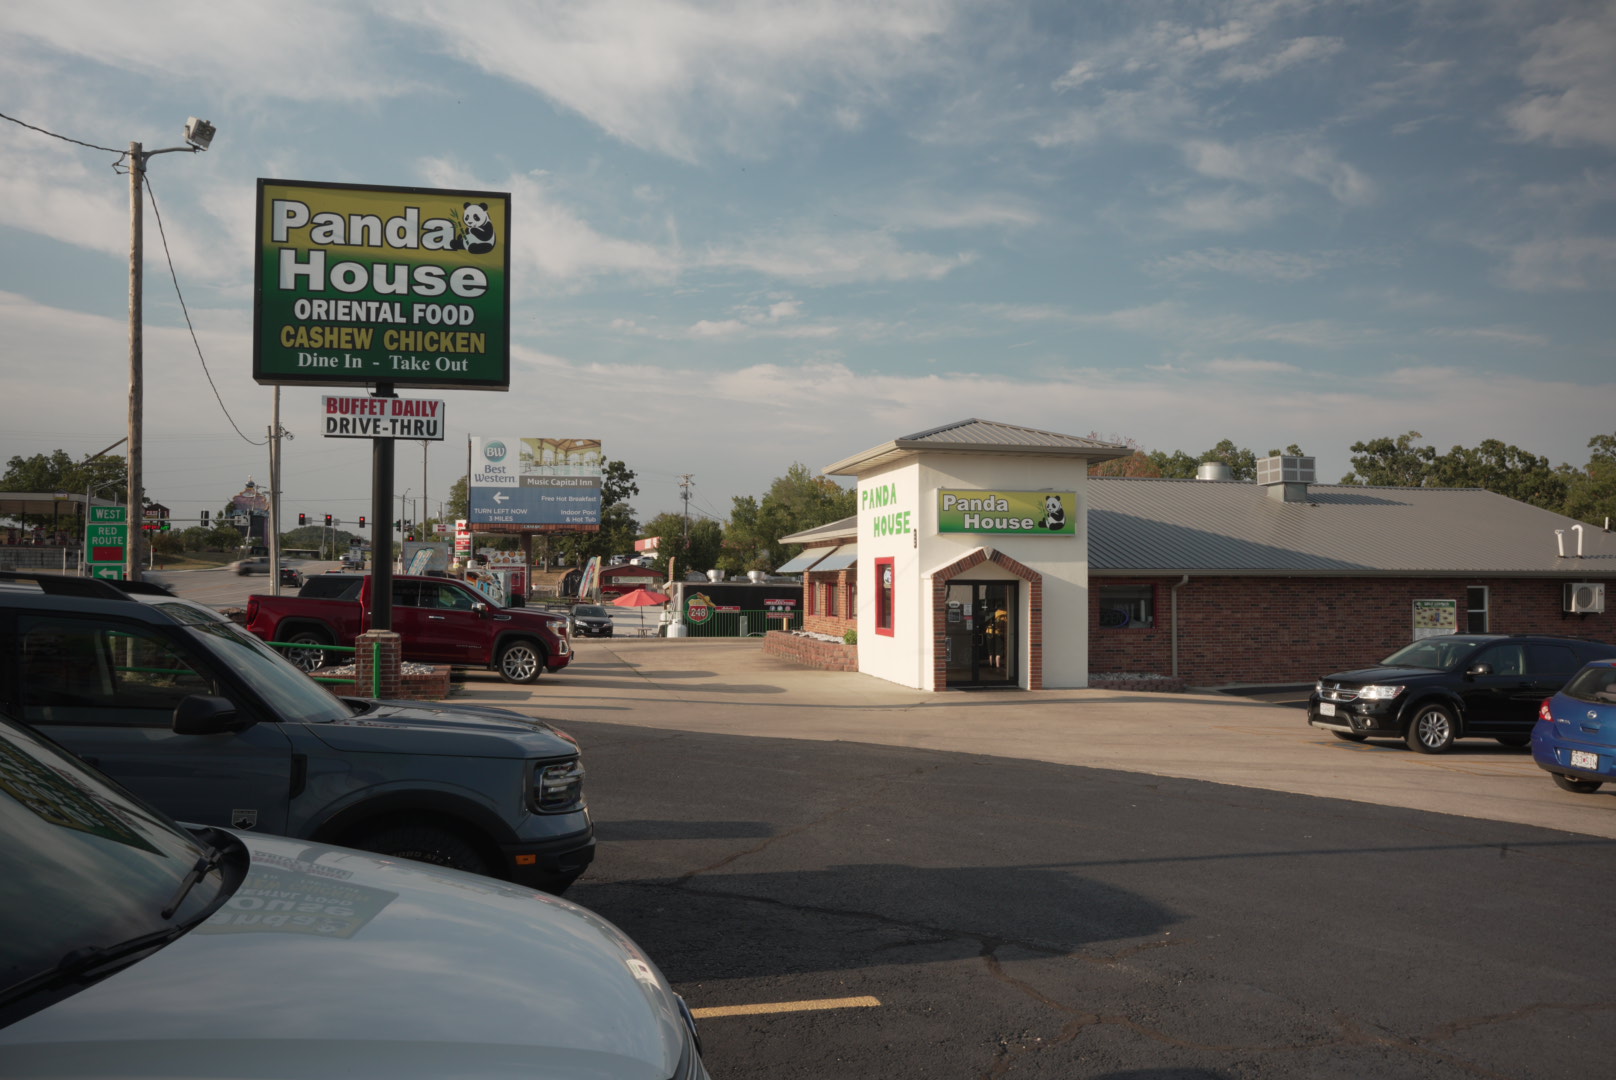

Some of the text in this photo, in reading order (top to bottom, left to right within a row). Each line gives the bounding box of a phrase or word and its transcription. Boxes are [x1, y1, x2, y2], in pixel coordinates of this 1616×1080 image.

[271, 199, 456, 250] Panda
[279, 248, 488, 297] House
[293, 298, 475, 326] ORIENTAL FOOD
[280, 324, 486, 354] CASHEW CHICKEN
[297, 352, 339, 368] Dine
[343, 354, 363, 369] In
[389, 354, 430, 371] Take
[435, 356, 469, 372] Out
[326, 397, 439, 417] BUFFET DAILY
[326, 417, 438, 437] DRIVE-THRU
[486, 446, 505, 457] BW
[474, 473, 515, 483] Western
[484, 464, 506, 474] Best
[527, 478, 549, 486] Music
[550, 478, 578, 487] Capital
[862, 482, 897, 511] PANDA
[942, 493, 1009, 513] Panda
[95, 508, 121, 519] WEST
[963, 513, 1035, 531] House
[98, 526, 117, 535] RED
[873, 510, 911, 538] HOUSE
[91, 536, 124, 545] ROUTE
[690, 607, 706, 617] 248
